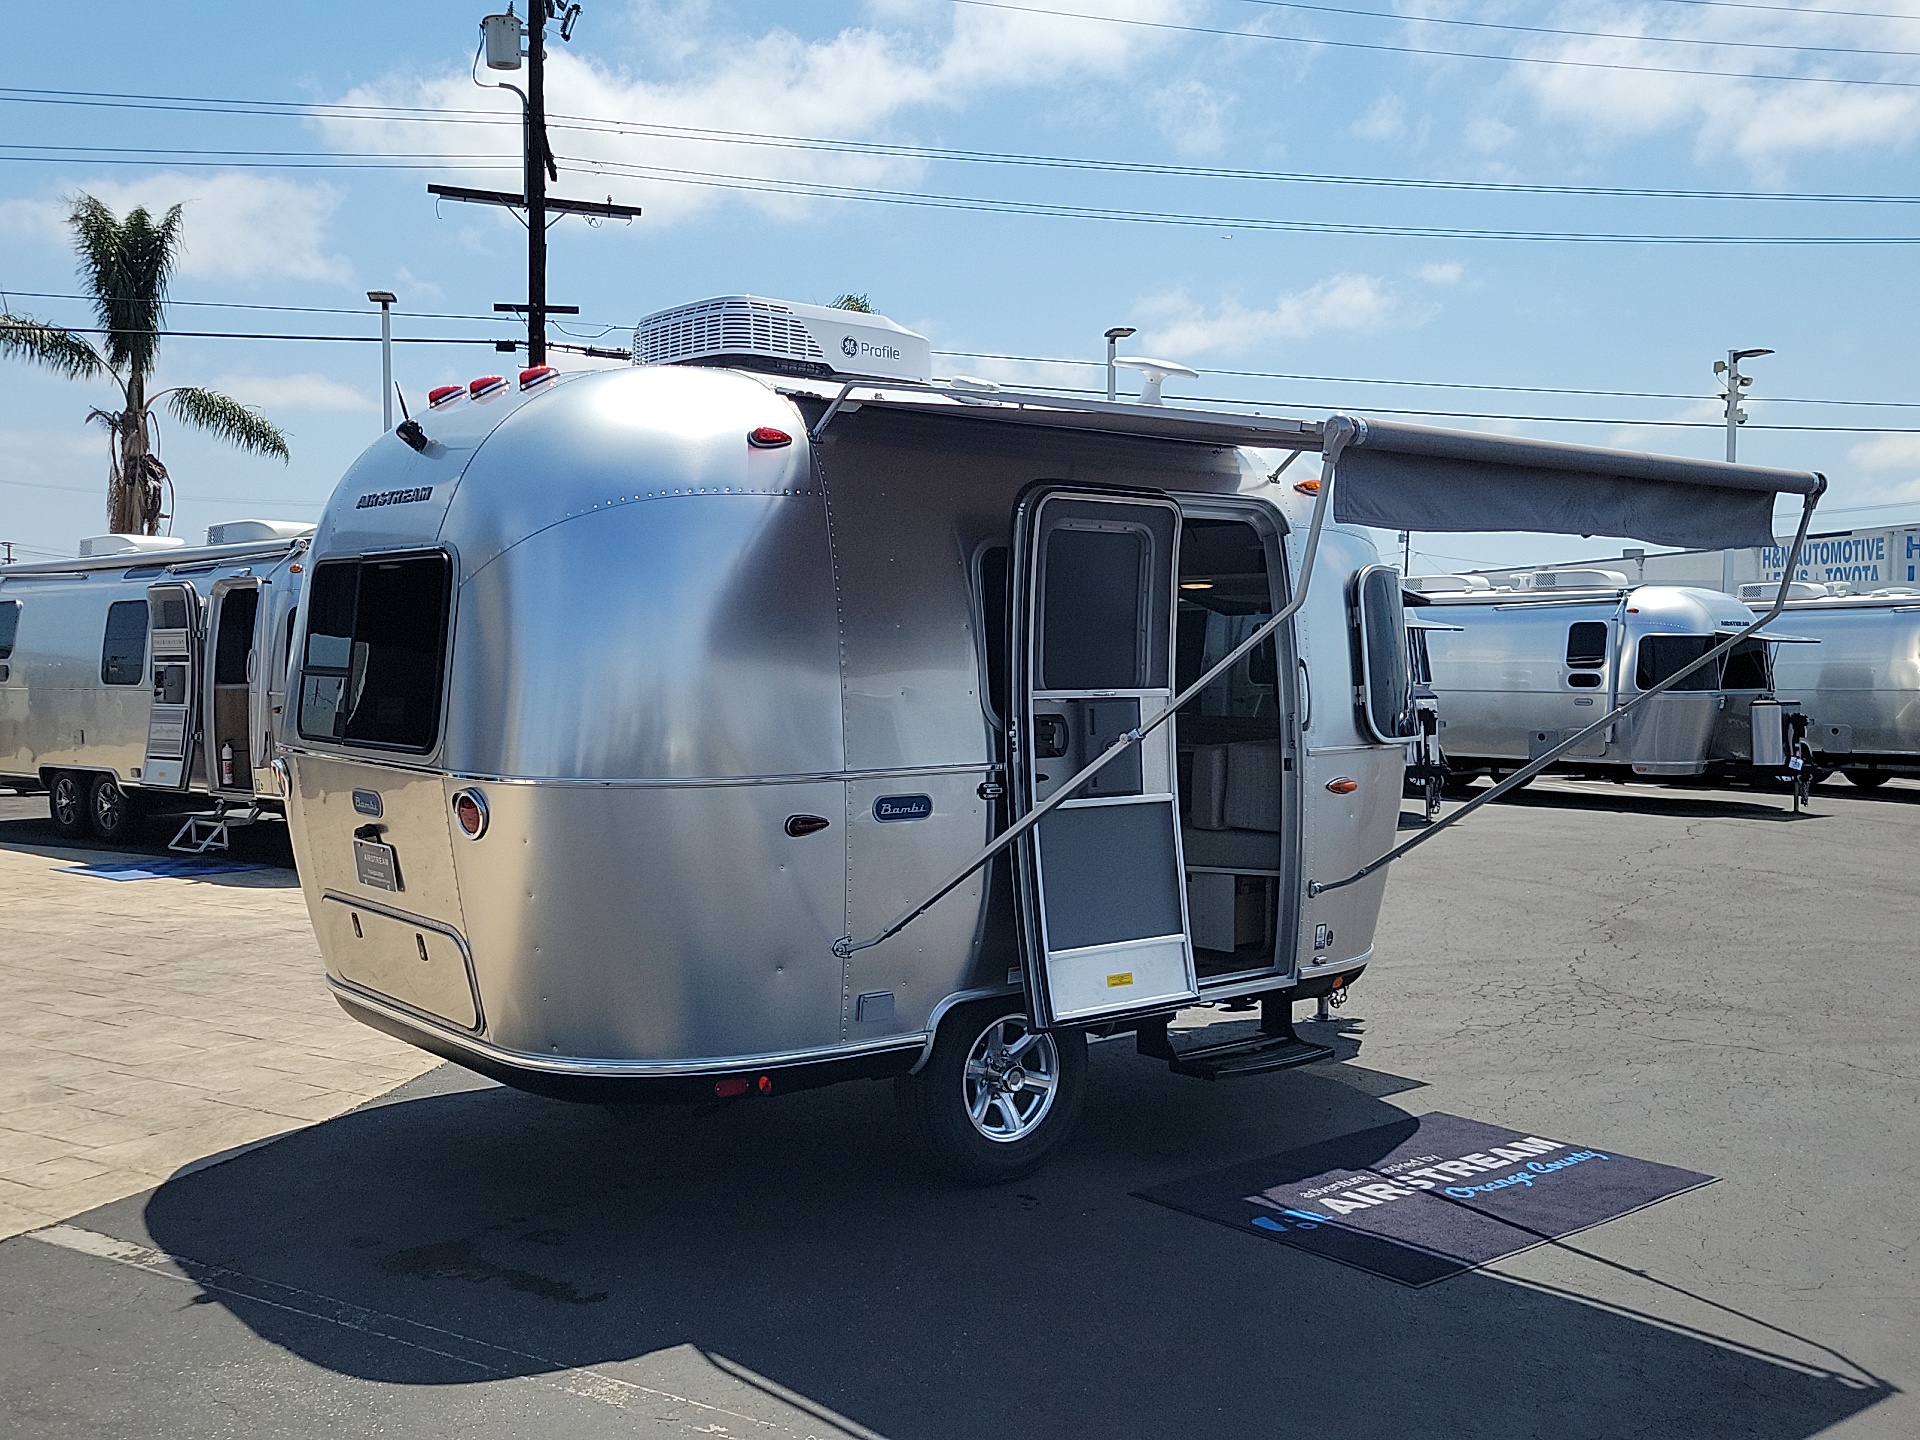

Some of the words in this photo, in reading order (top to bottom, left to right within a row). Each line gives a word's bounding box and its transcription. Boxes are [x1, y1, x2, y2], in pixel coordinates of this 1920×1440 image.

[861, 342, 900, 360] Profile
[355, 485, 434, 510] AIRSTREAM
[1762, 545, 1790, 569] H&N
[1797, 537, 1885, 566] AUTOMOTIVE
[1765, 569, 1808, 581] LES
[1825, 565, 1879, 581] TOYOTA
[355, 796, 378, 811] Bambi
[880, 802, 927, 815] Bambi
[363, 853, 389, 866] AIRSTREAM
[1317, 1136, 1567, 1216] AIRSTREAM
[1445, 1171, 1537, 1199] Orange
[1526, 1150, 1610, 1174] County
